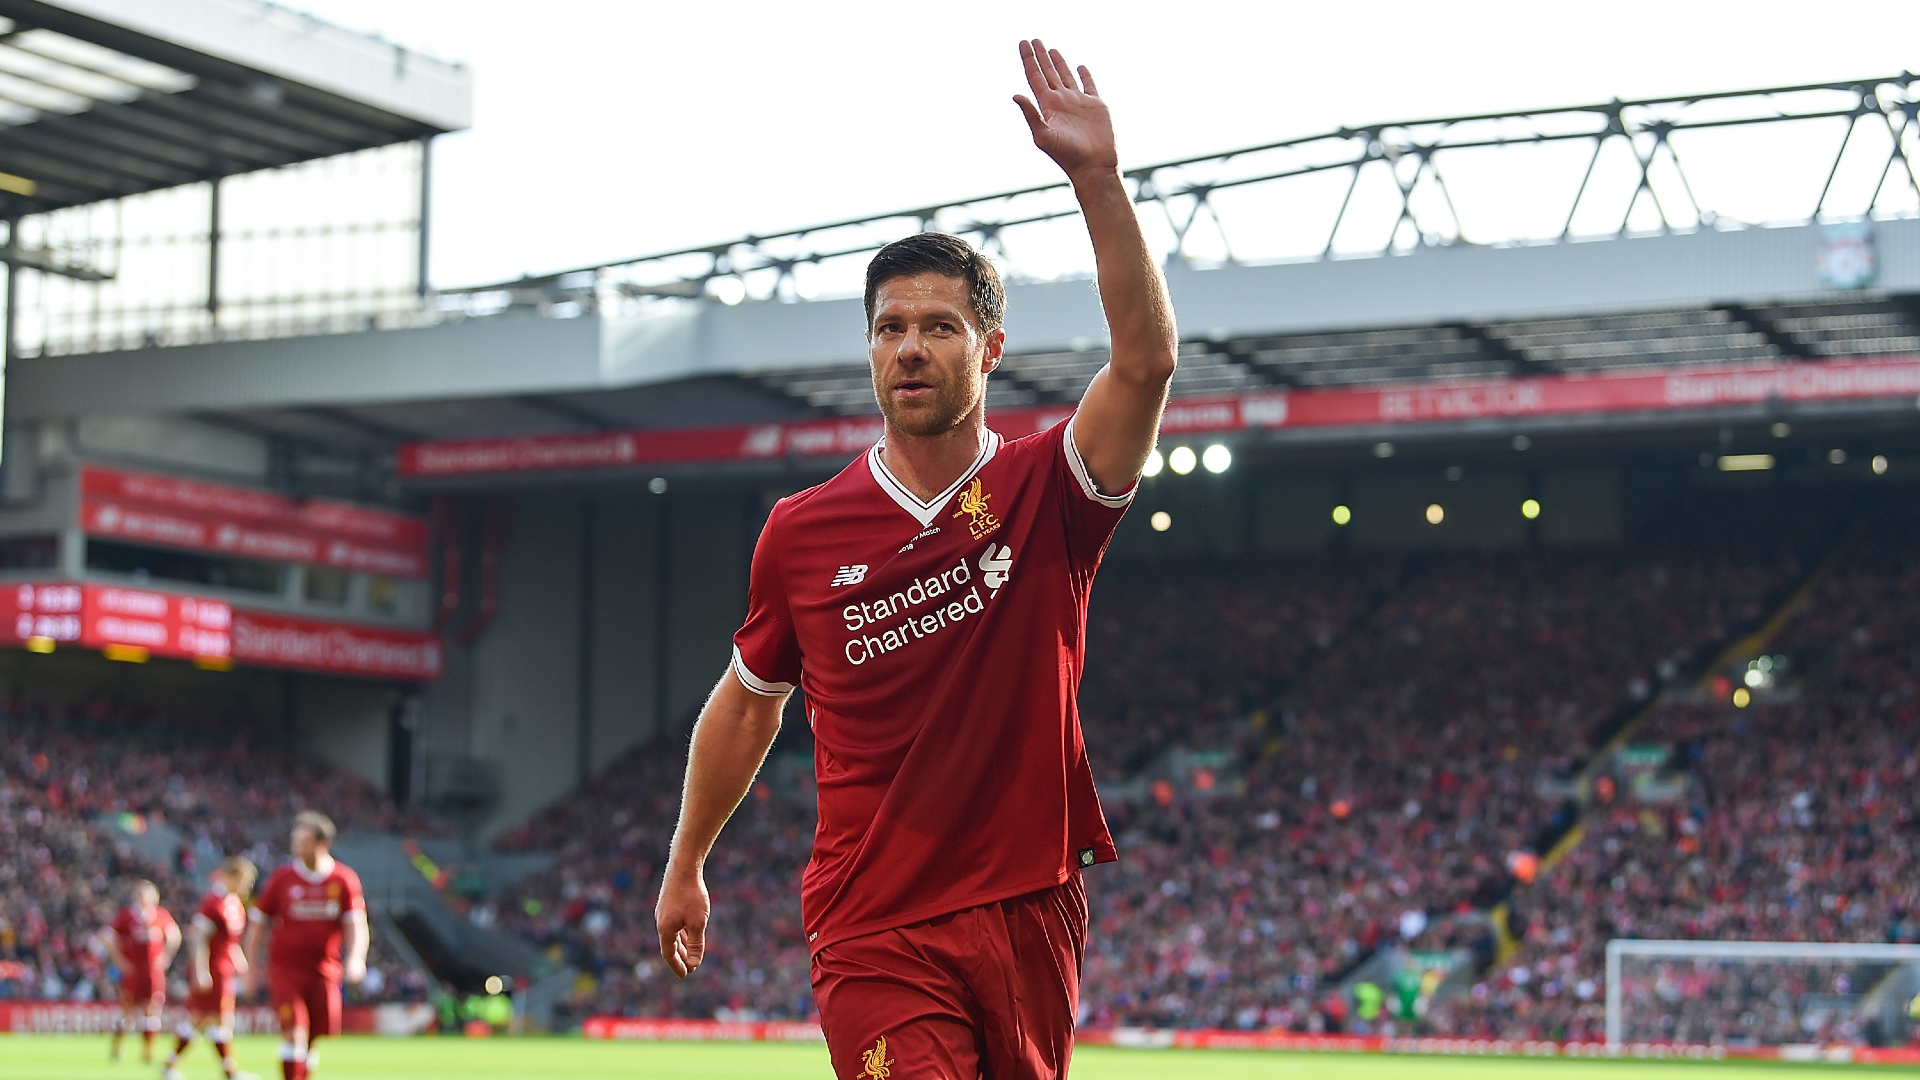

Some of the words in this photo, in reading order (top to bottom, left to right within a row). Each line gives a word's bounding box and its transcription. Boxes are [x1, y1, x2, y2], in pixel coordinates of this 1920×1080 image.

[919, 526, 941, 539] Match
[842, 557, 972, 631] Standard
[845, 585, 985, 665] Chartered
